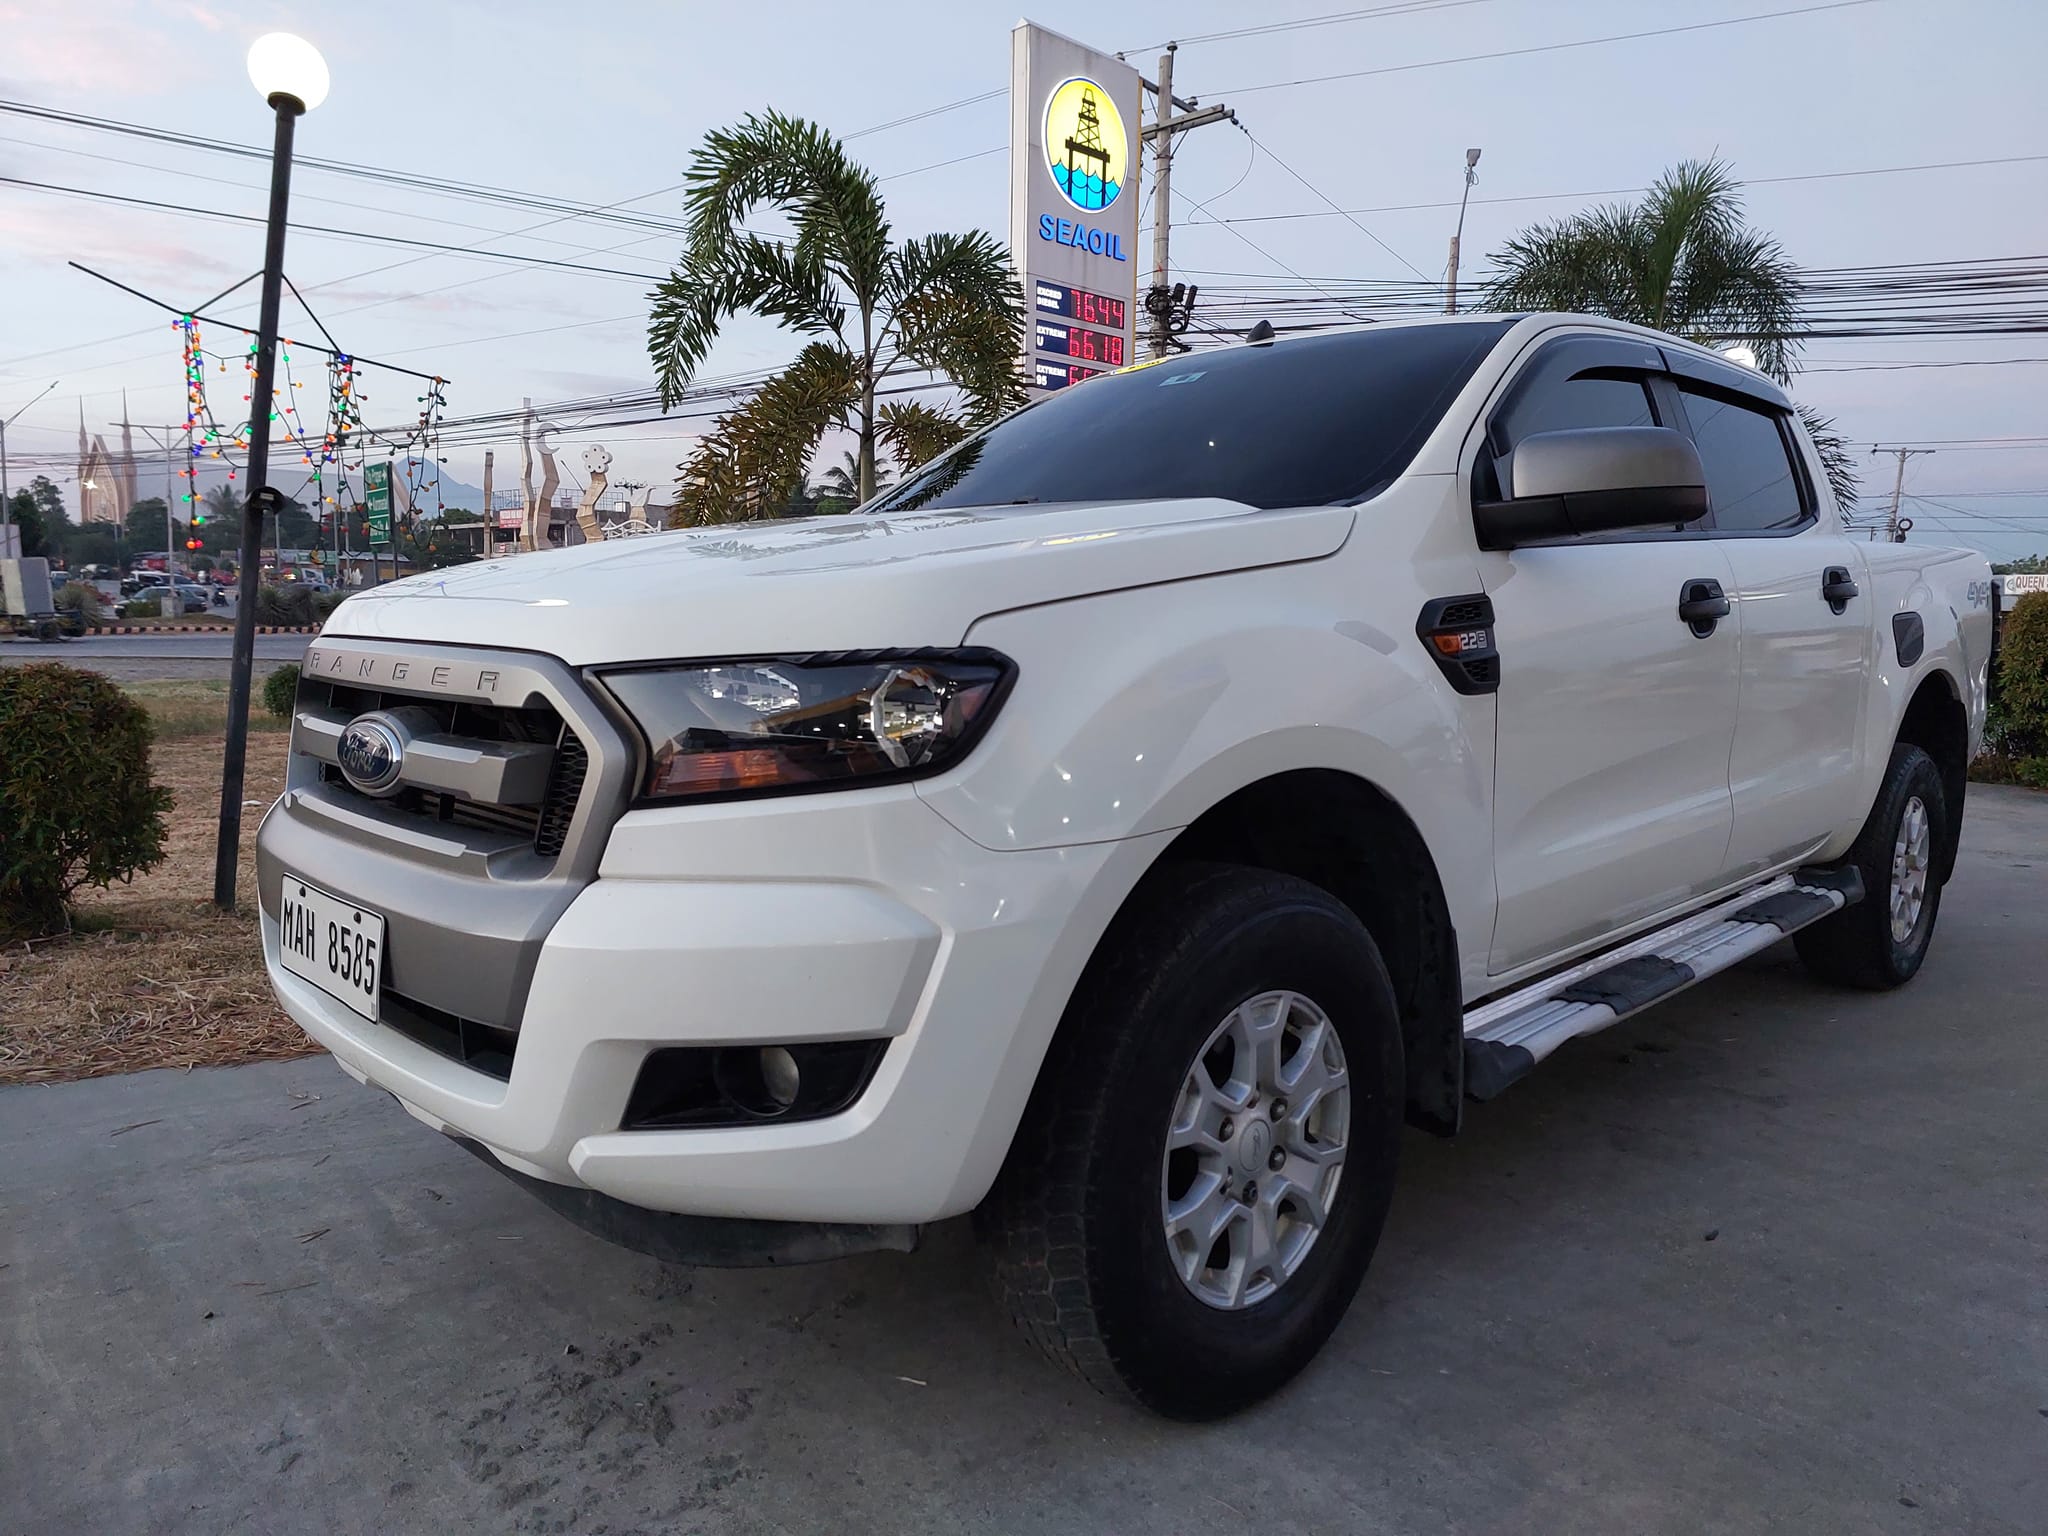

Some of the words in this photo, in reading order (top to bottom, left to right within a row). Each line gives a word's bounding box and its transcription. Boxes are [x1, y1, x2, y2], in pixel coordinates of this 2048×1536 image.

[1039, 213, 1127, 262] SEAOIL
[1070, 290, 1123, 328] 76.44
[1036, 325, 1067, 339] EXTREME
[1036, 335, 1044, 347] U
[1069, 327, 1122, 365] 66.18
[1036, 364, 1067, 378] EXTREME
[1036, 375, 1048, 386] 95
[2016, 576, 2045, 588] QUEEN
[310, 652, 501, 692] RANGER
[282, 898, 316, 962] MAH
[328, 921, 377, 995] 8585
